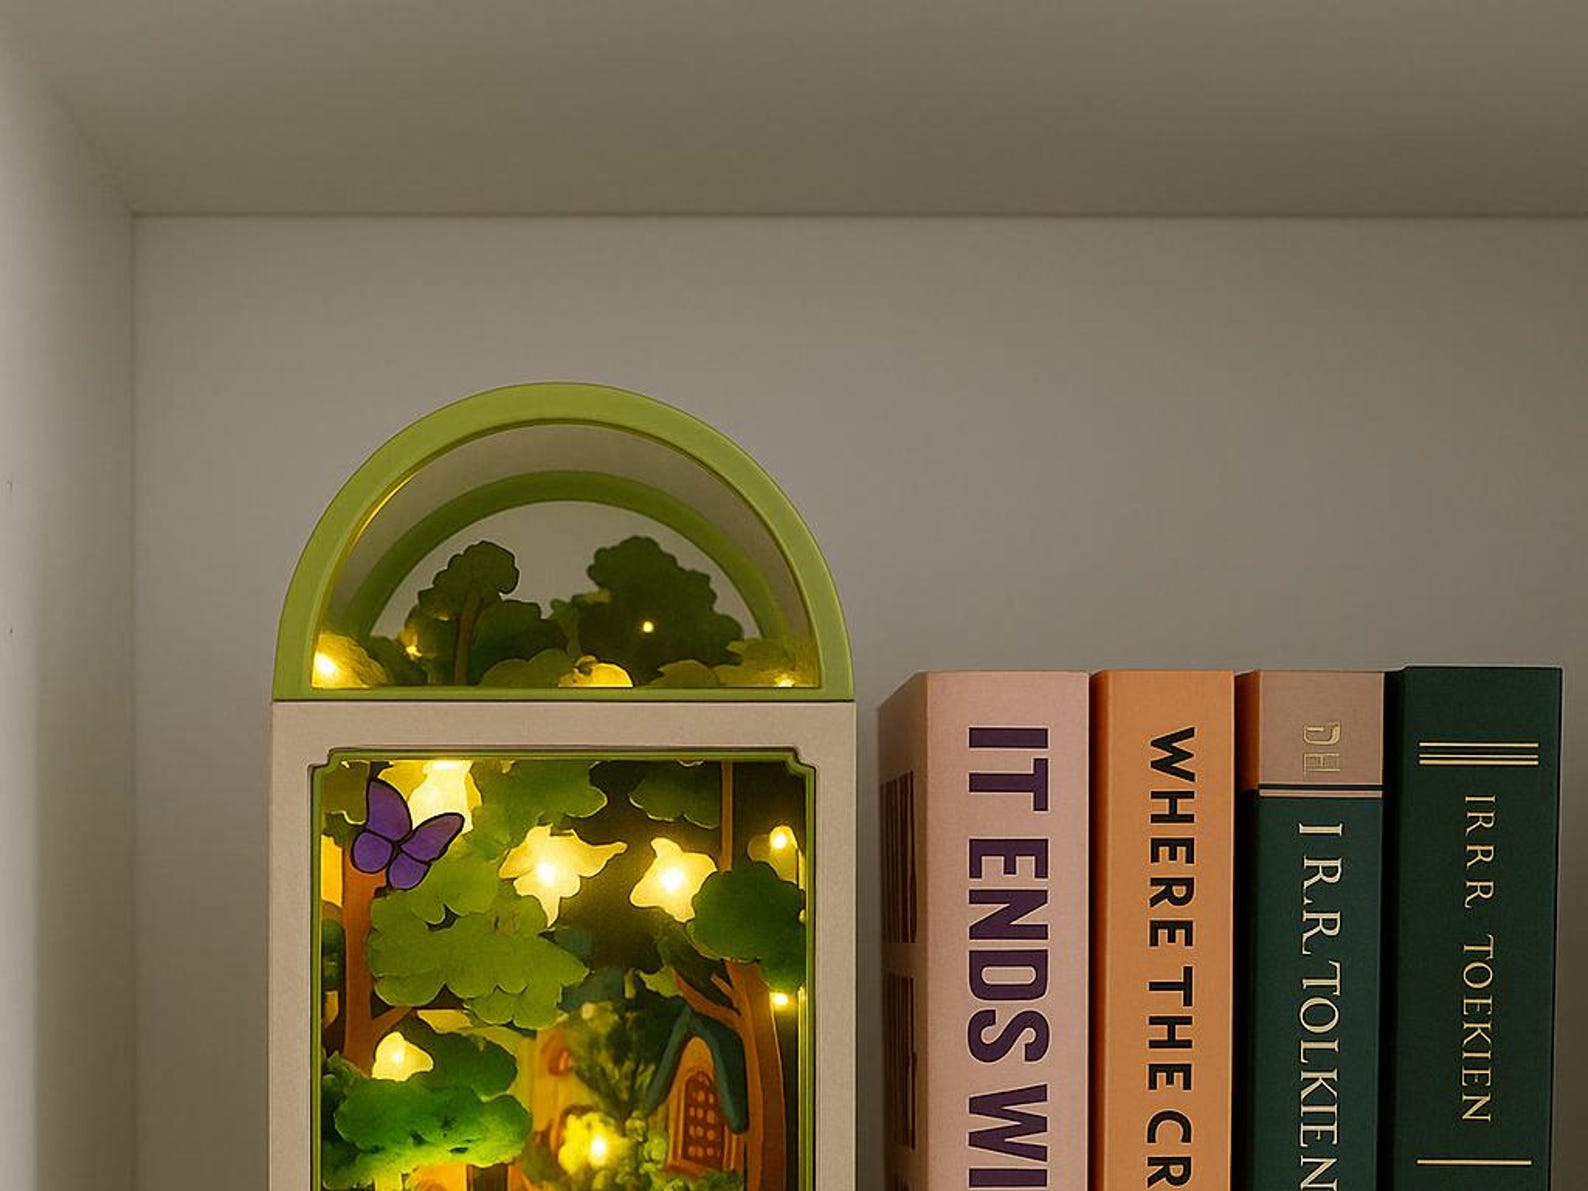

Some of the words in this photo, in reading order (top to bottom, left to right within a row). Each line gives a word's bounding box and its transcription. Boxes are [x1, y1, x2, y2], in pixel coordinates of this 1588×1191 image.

[968, 726, 1049, 811] IT
[1149, 726, 1196, 948] WHERE
[966, 838, 1050, 1063] ENDS
[1148, 966, 1194, 1092] THE
